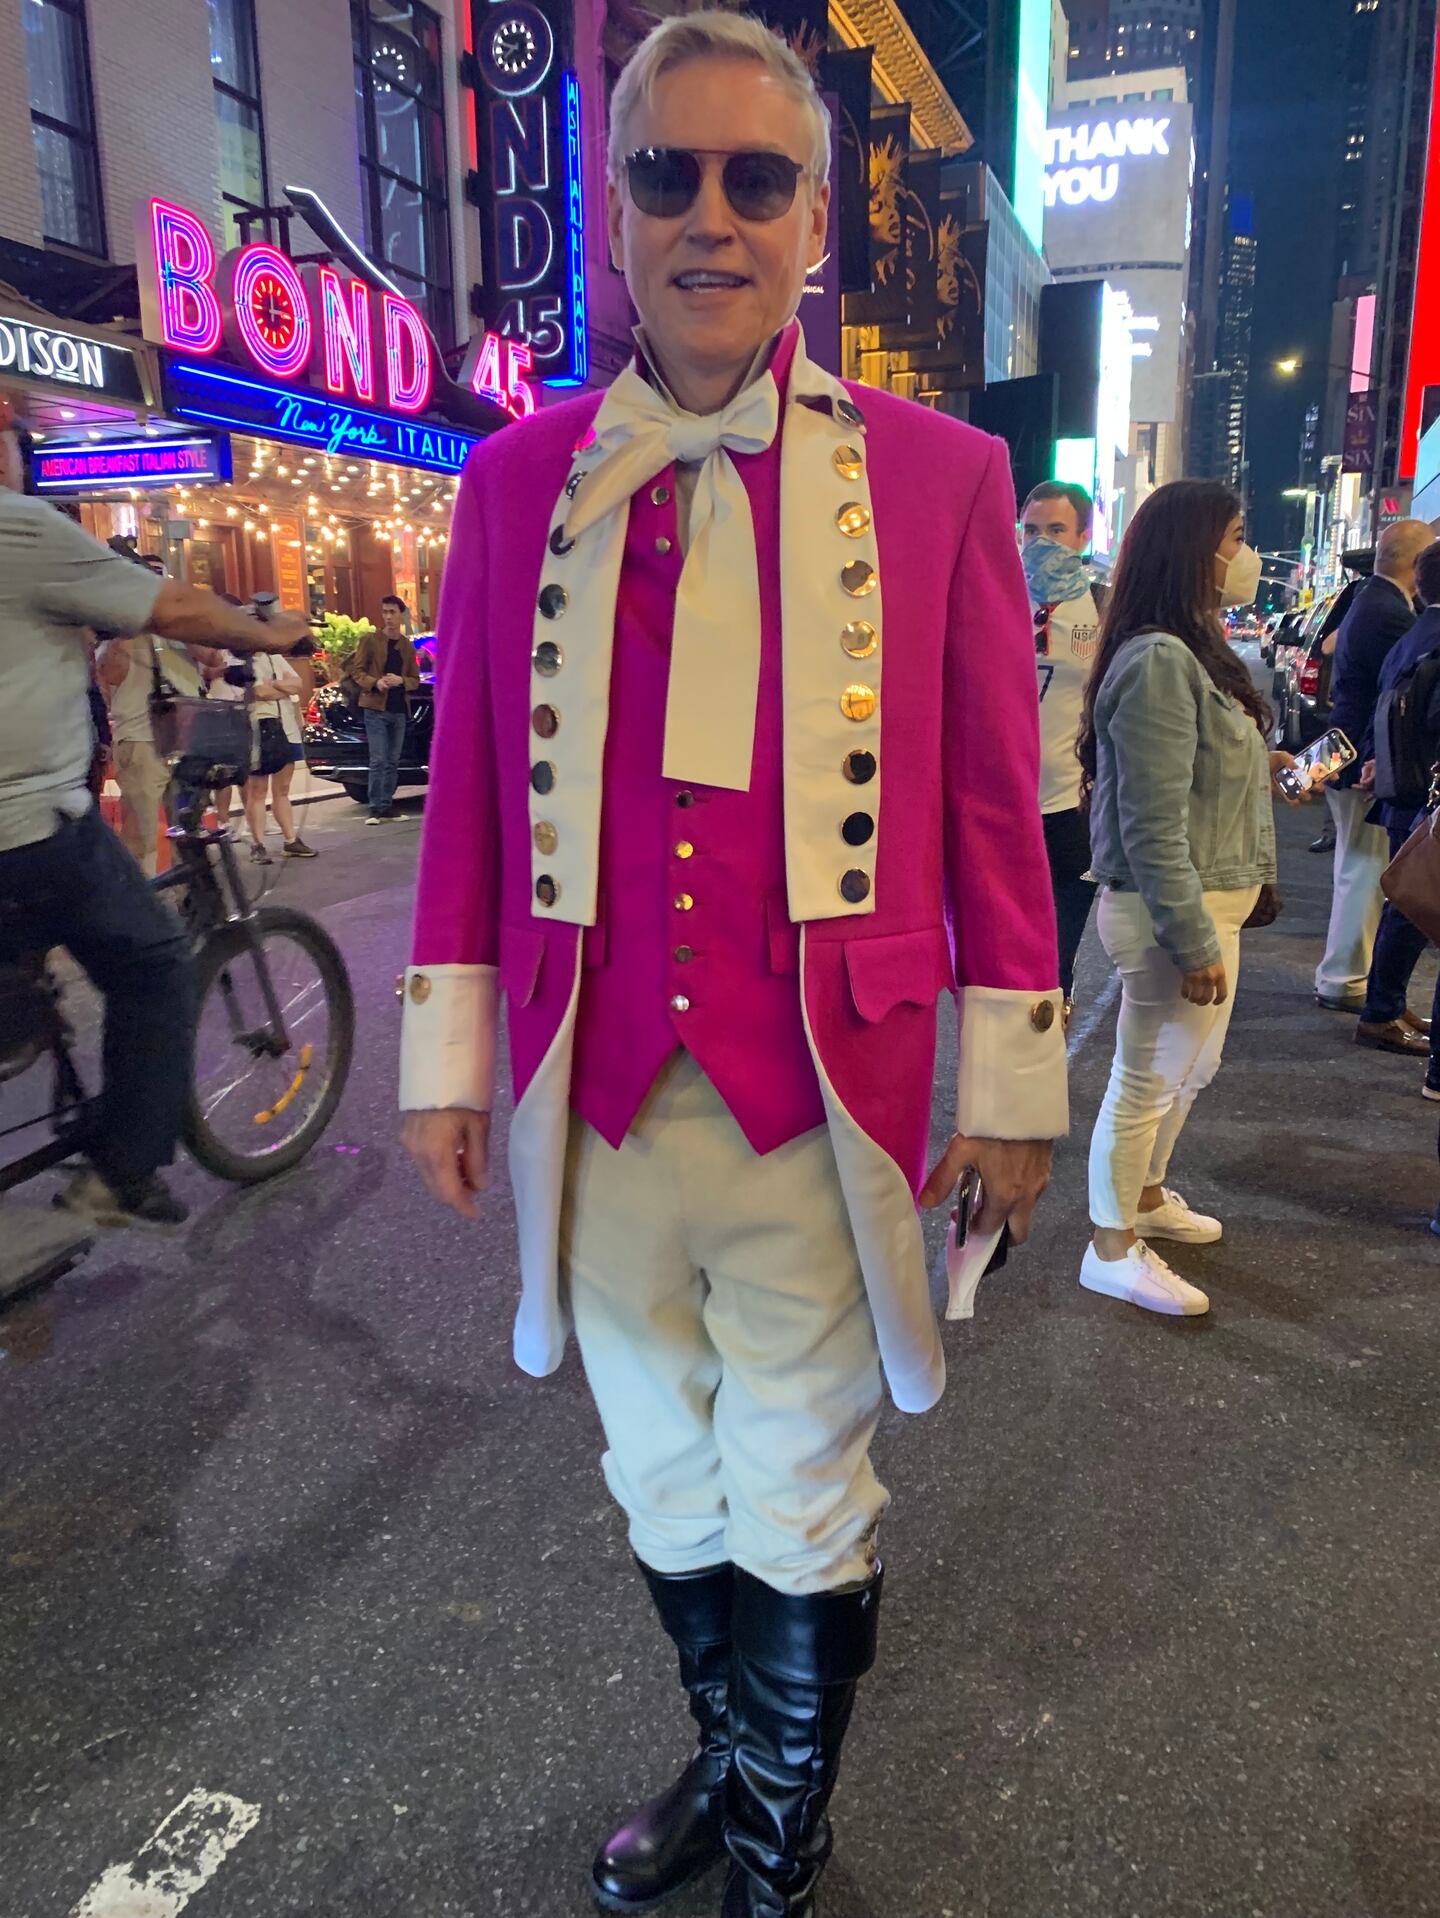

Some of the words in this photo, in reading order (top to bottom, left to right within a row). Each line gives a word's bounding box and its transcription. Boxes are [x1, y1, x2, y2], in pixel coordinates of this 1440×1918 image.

[478, 0, 554, 289] OND
[1043, 117, 1171, 165] THANK
[571, 180, 583, 252] ALL
[1041, 163, 1120, 207] YOU
[150, 197, 431, 412] BOND
[497, 296, 565, 358] 45
[471, 331, 536, 422] 45
[275, 396, 325, 433] New
[326, 412, 388, 455] York
[41, 457, 88, 478] AMERICAN
[88, 454, 140, 474] BREAKFAST
[141, 450, 177, 471] ITALIAN
[177, 449, 208, 469] STYLE
